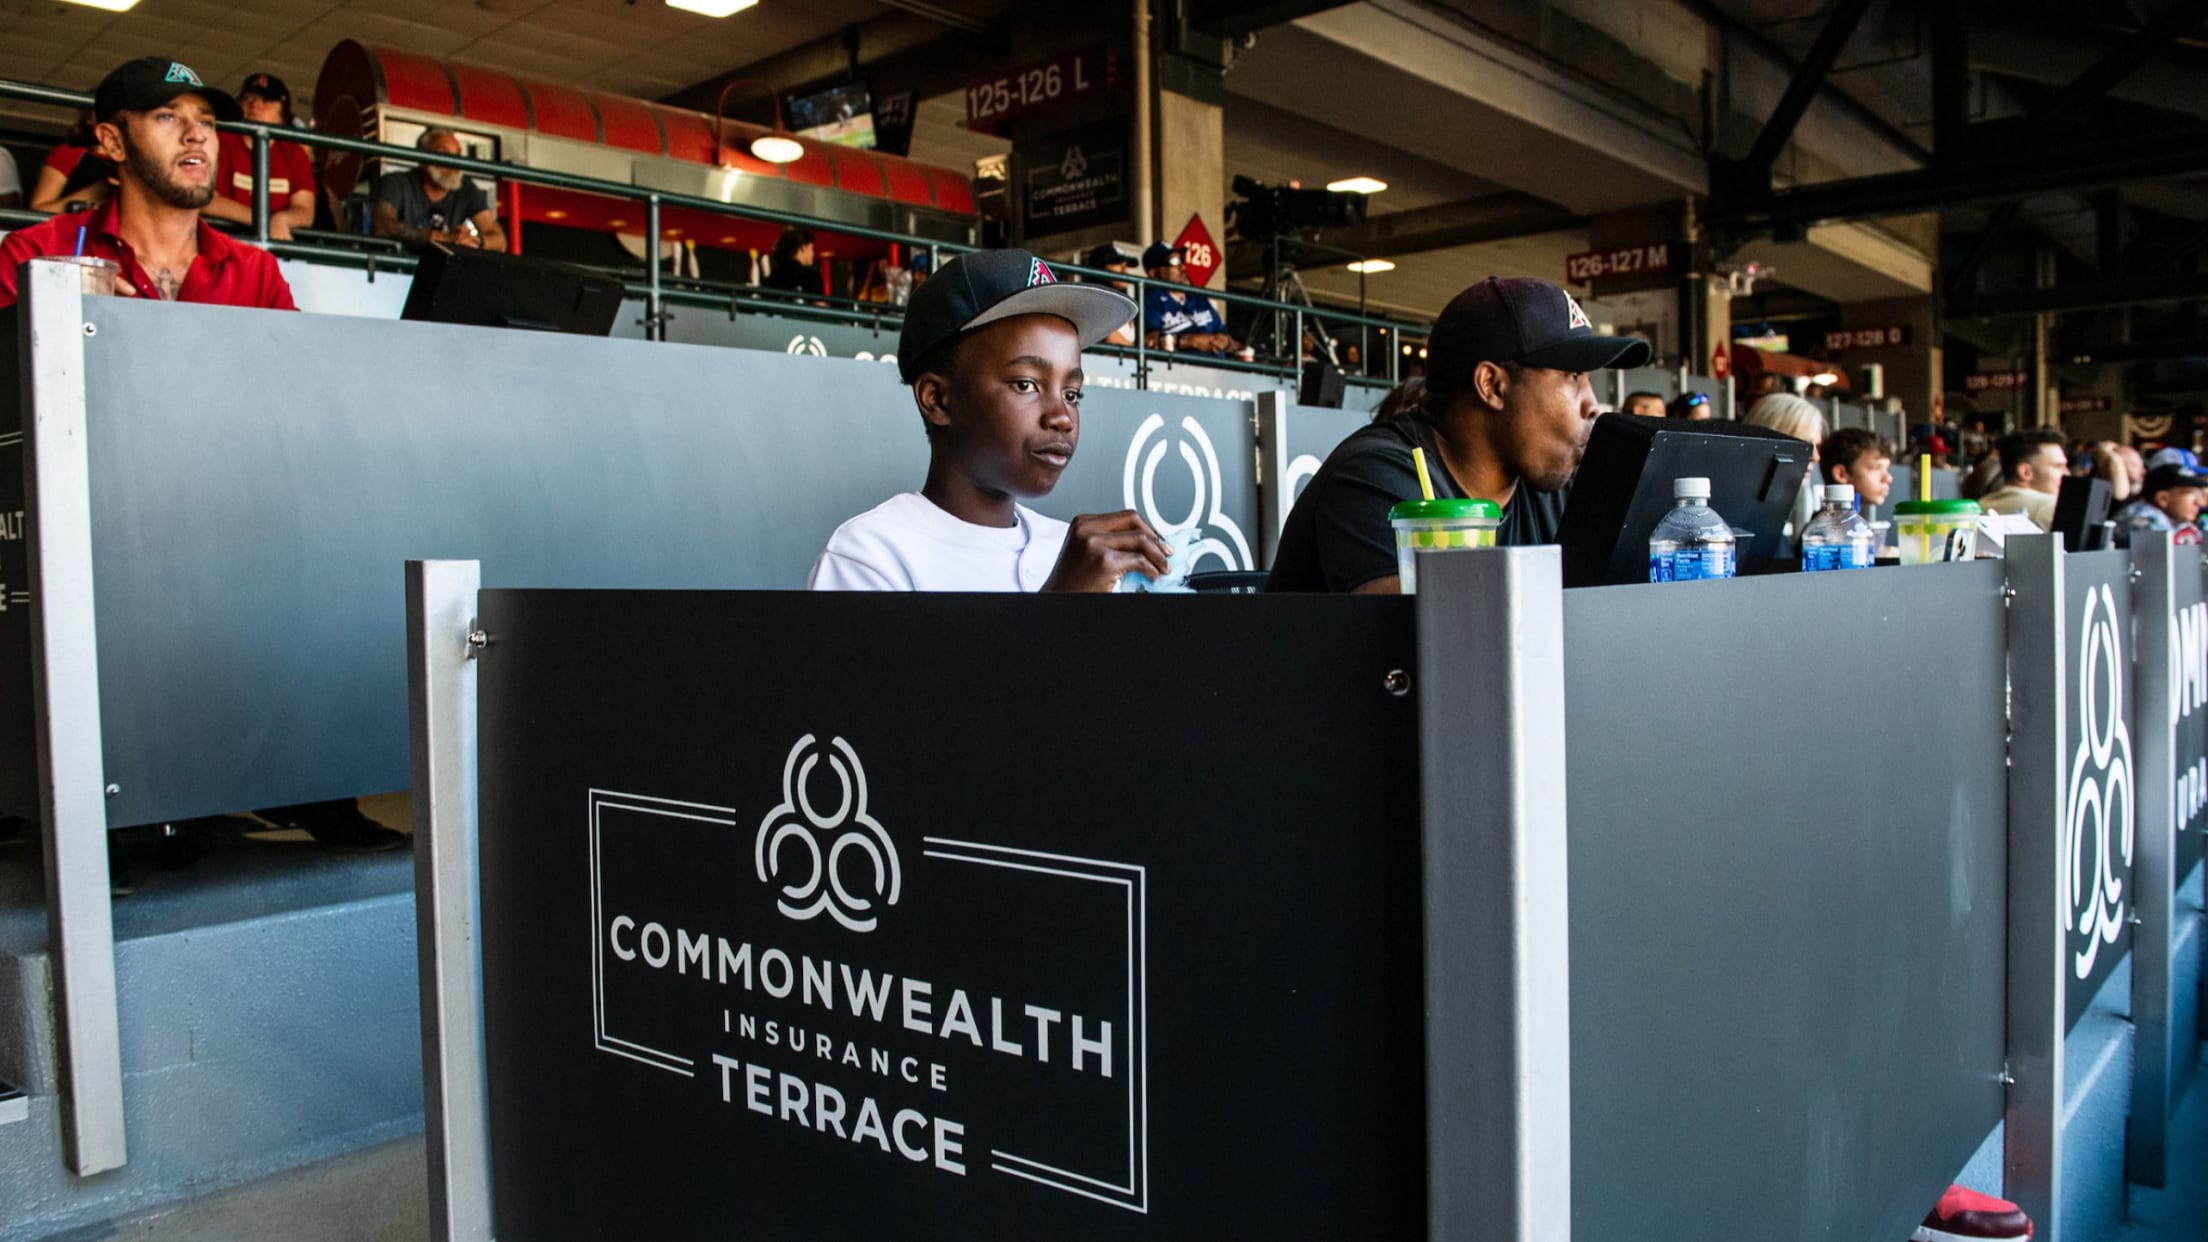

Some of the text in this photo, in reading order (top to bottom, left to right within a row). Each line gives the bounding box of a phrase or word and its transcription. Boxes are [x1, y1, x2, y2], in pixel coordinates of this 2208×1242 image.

[969, 56, 1089, 119] 125-126 L
[1184, 241, 1212, 268] 126
[1569, 245, 1668, 279] 126-127 M
[610, 914, 1114, 1078] COMMONWEALTH
[723, 1009, 949, 1092] INSURANCE
[711, 1053, 967, 1177] TERRACE
